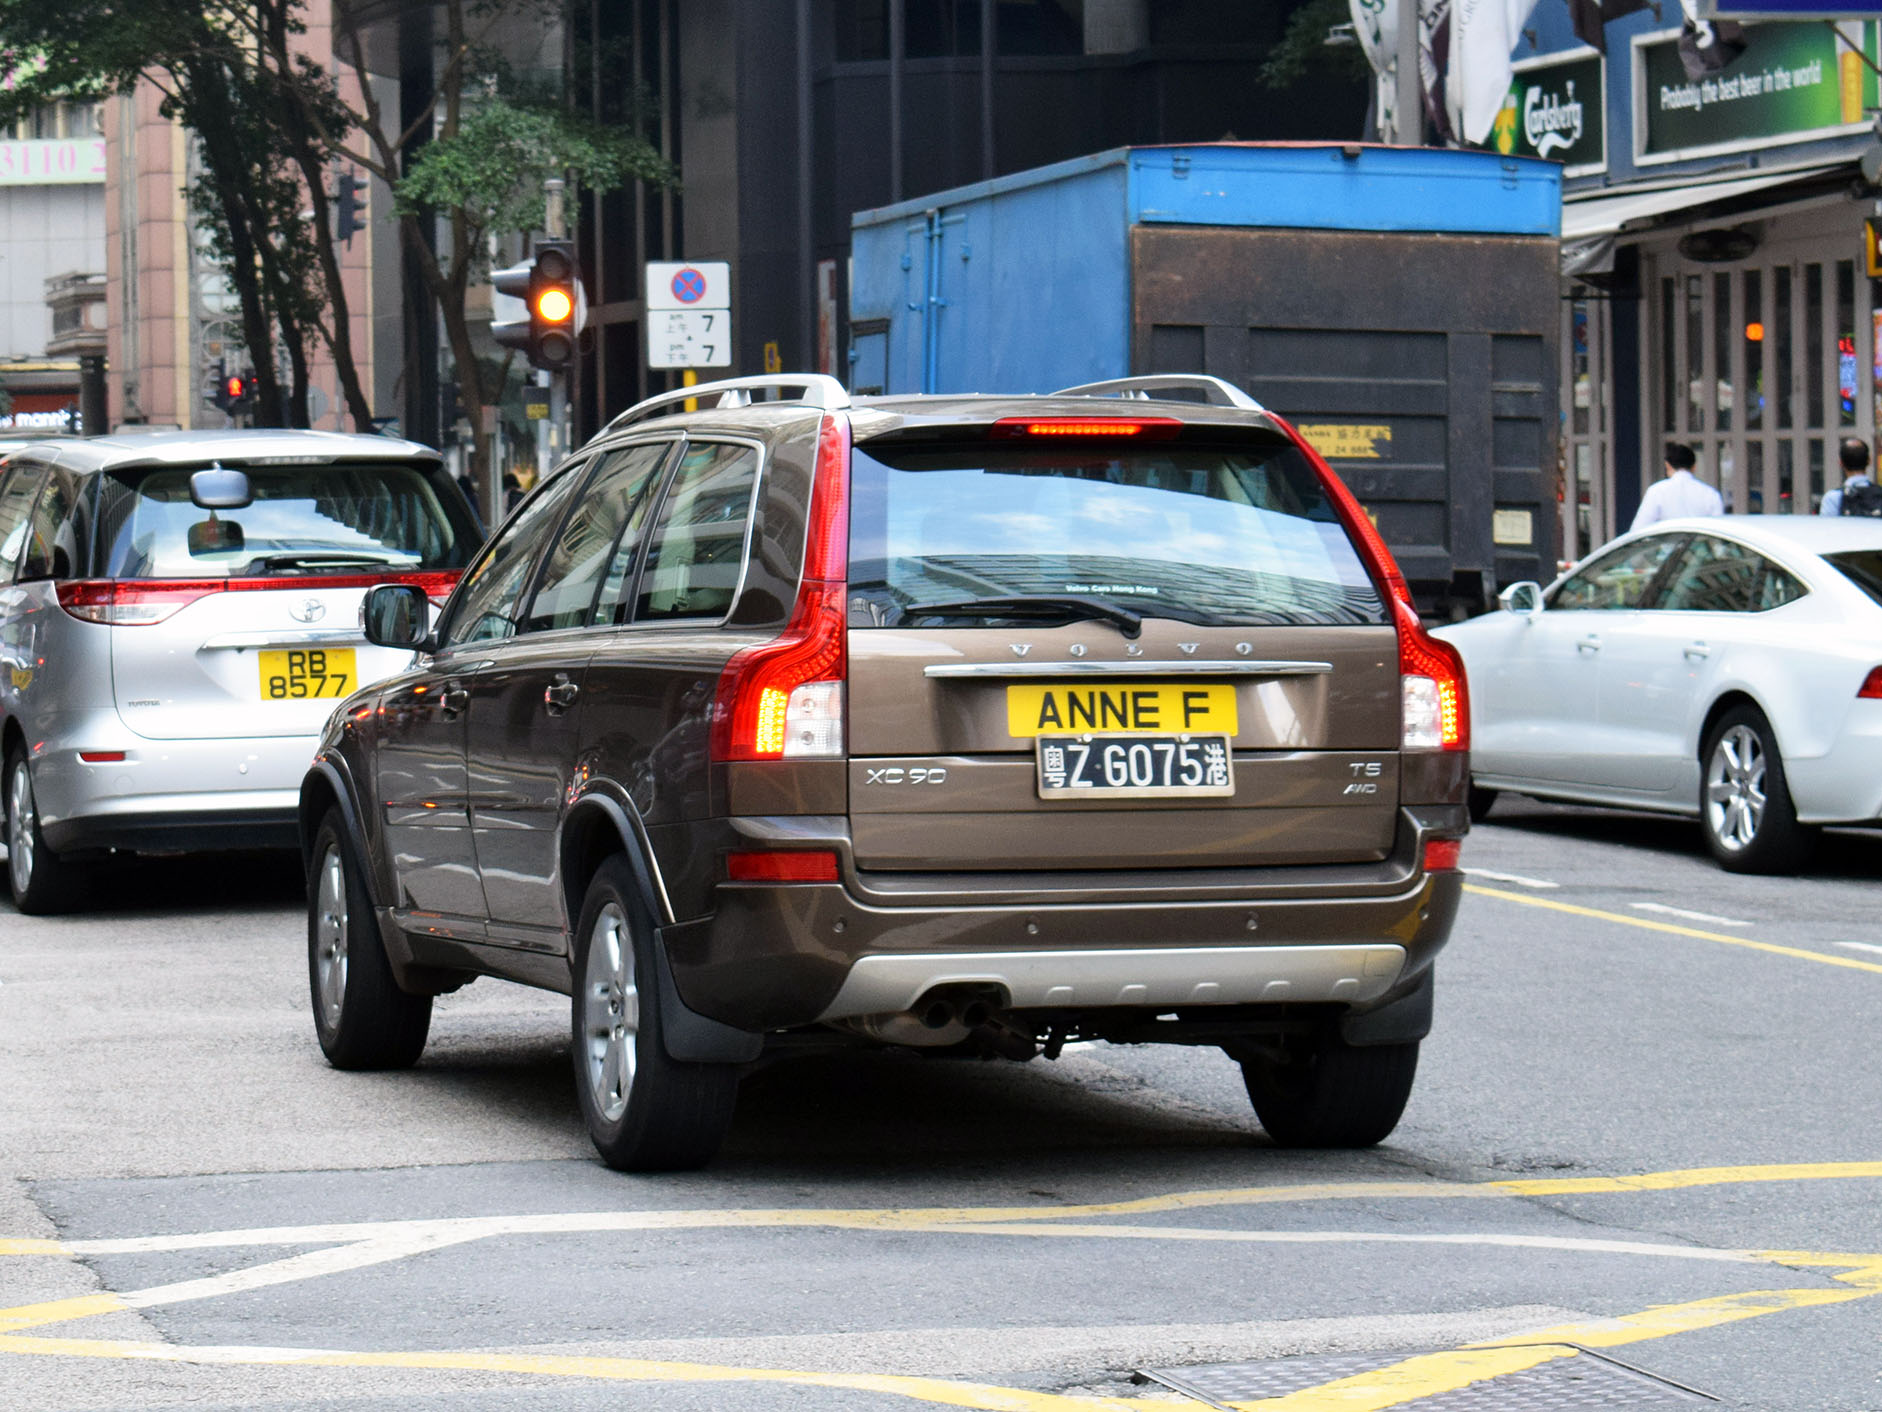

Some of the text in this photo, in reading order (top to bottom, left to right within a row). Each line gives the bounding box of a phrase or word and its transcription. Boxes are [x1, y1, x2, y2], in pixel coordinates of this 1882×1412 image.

[1661, 58, 1822, 111] Probably the best beer in the world
[1524, 80, 1583, 158] Carlsberg
[1112, 585, 1135, 594] Hong
[1136, 585, 1159, 594] Kong
[1009, 642, 1254, 657] VOLVO
[288, 651, 327, 675] RB
[269, 674, 348, 699] 8577
[1037, 690, 1210, 729] ANNE F
[1349, 762, 1382, 777] T5
[1343, 783, 1377, 794] AWD
